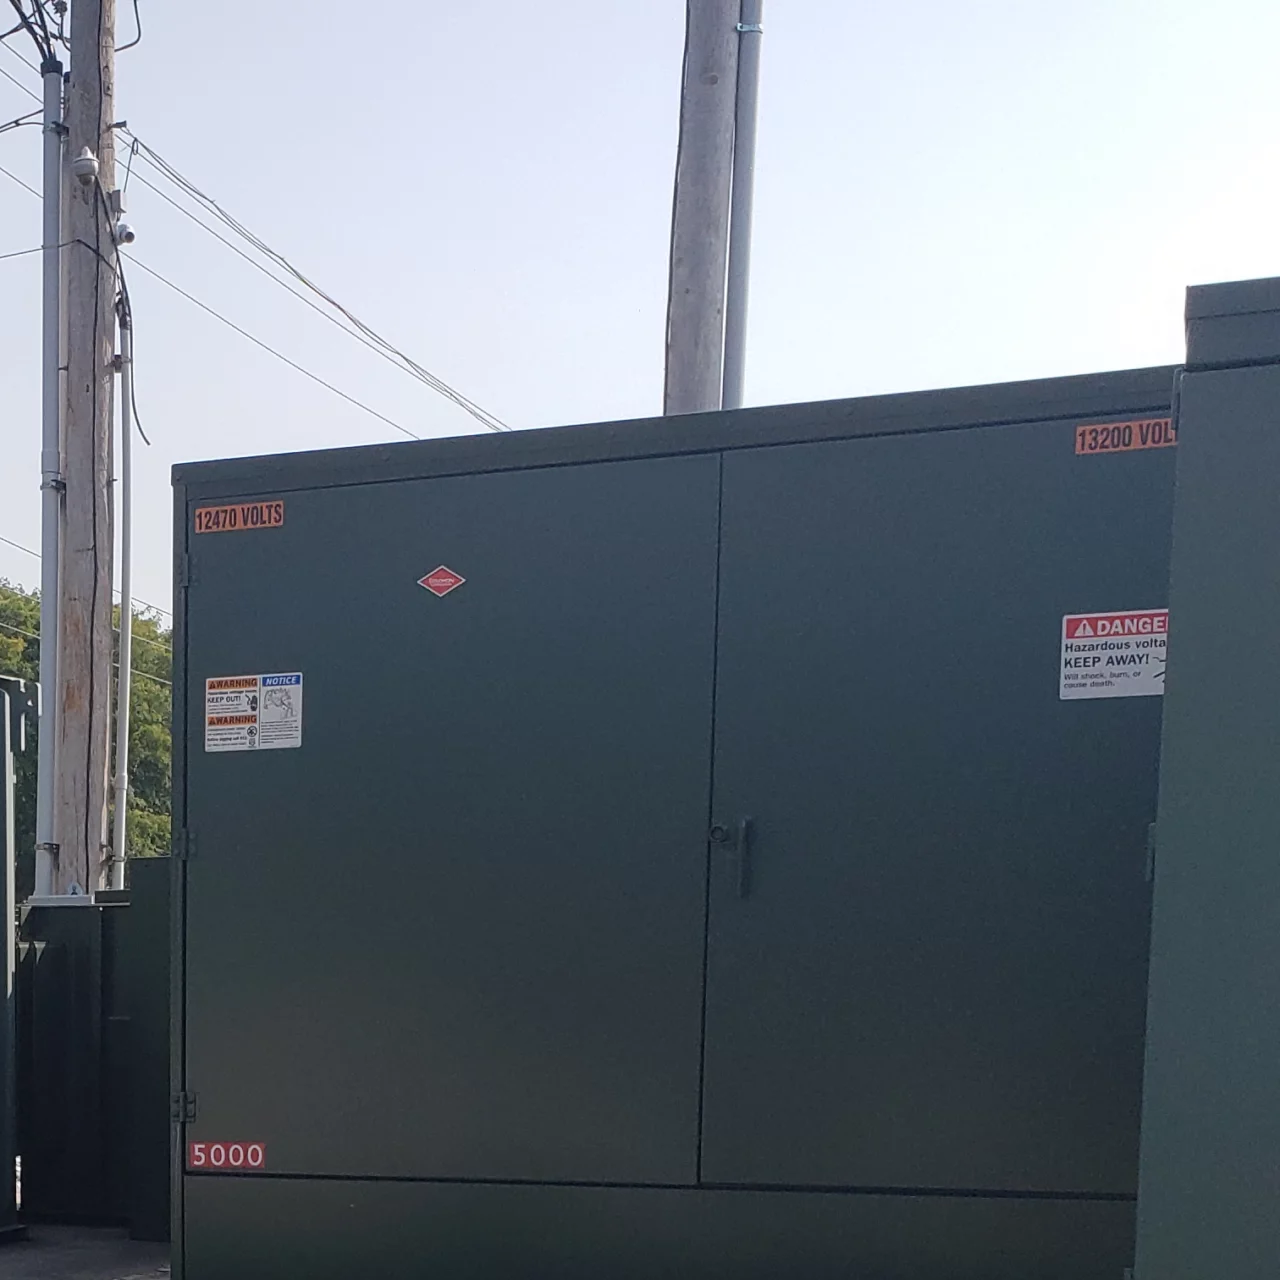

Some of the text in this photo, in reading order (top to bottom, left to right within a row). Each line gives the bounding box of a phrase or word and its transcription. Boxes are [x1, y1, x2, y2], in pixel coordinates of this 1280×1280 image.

[1078, 421, 1173, 451] 13200 VOL
[196, 503, 282, 531] 12470 VOLTS
[1096, 616, 1168, 636] DANGE
[1065, 638, 1167, 653] Hazardous volta
[1064, 653, 1150, 669] KEEP AWAY!
[215, 679, 258, 689] WARNING
[265, 677, 297, 686] NOTICE
[215, 715, 257, 726] WARNING
[193, 1144, 263, 1166] 5000
